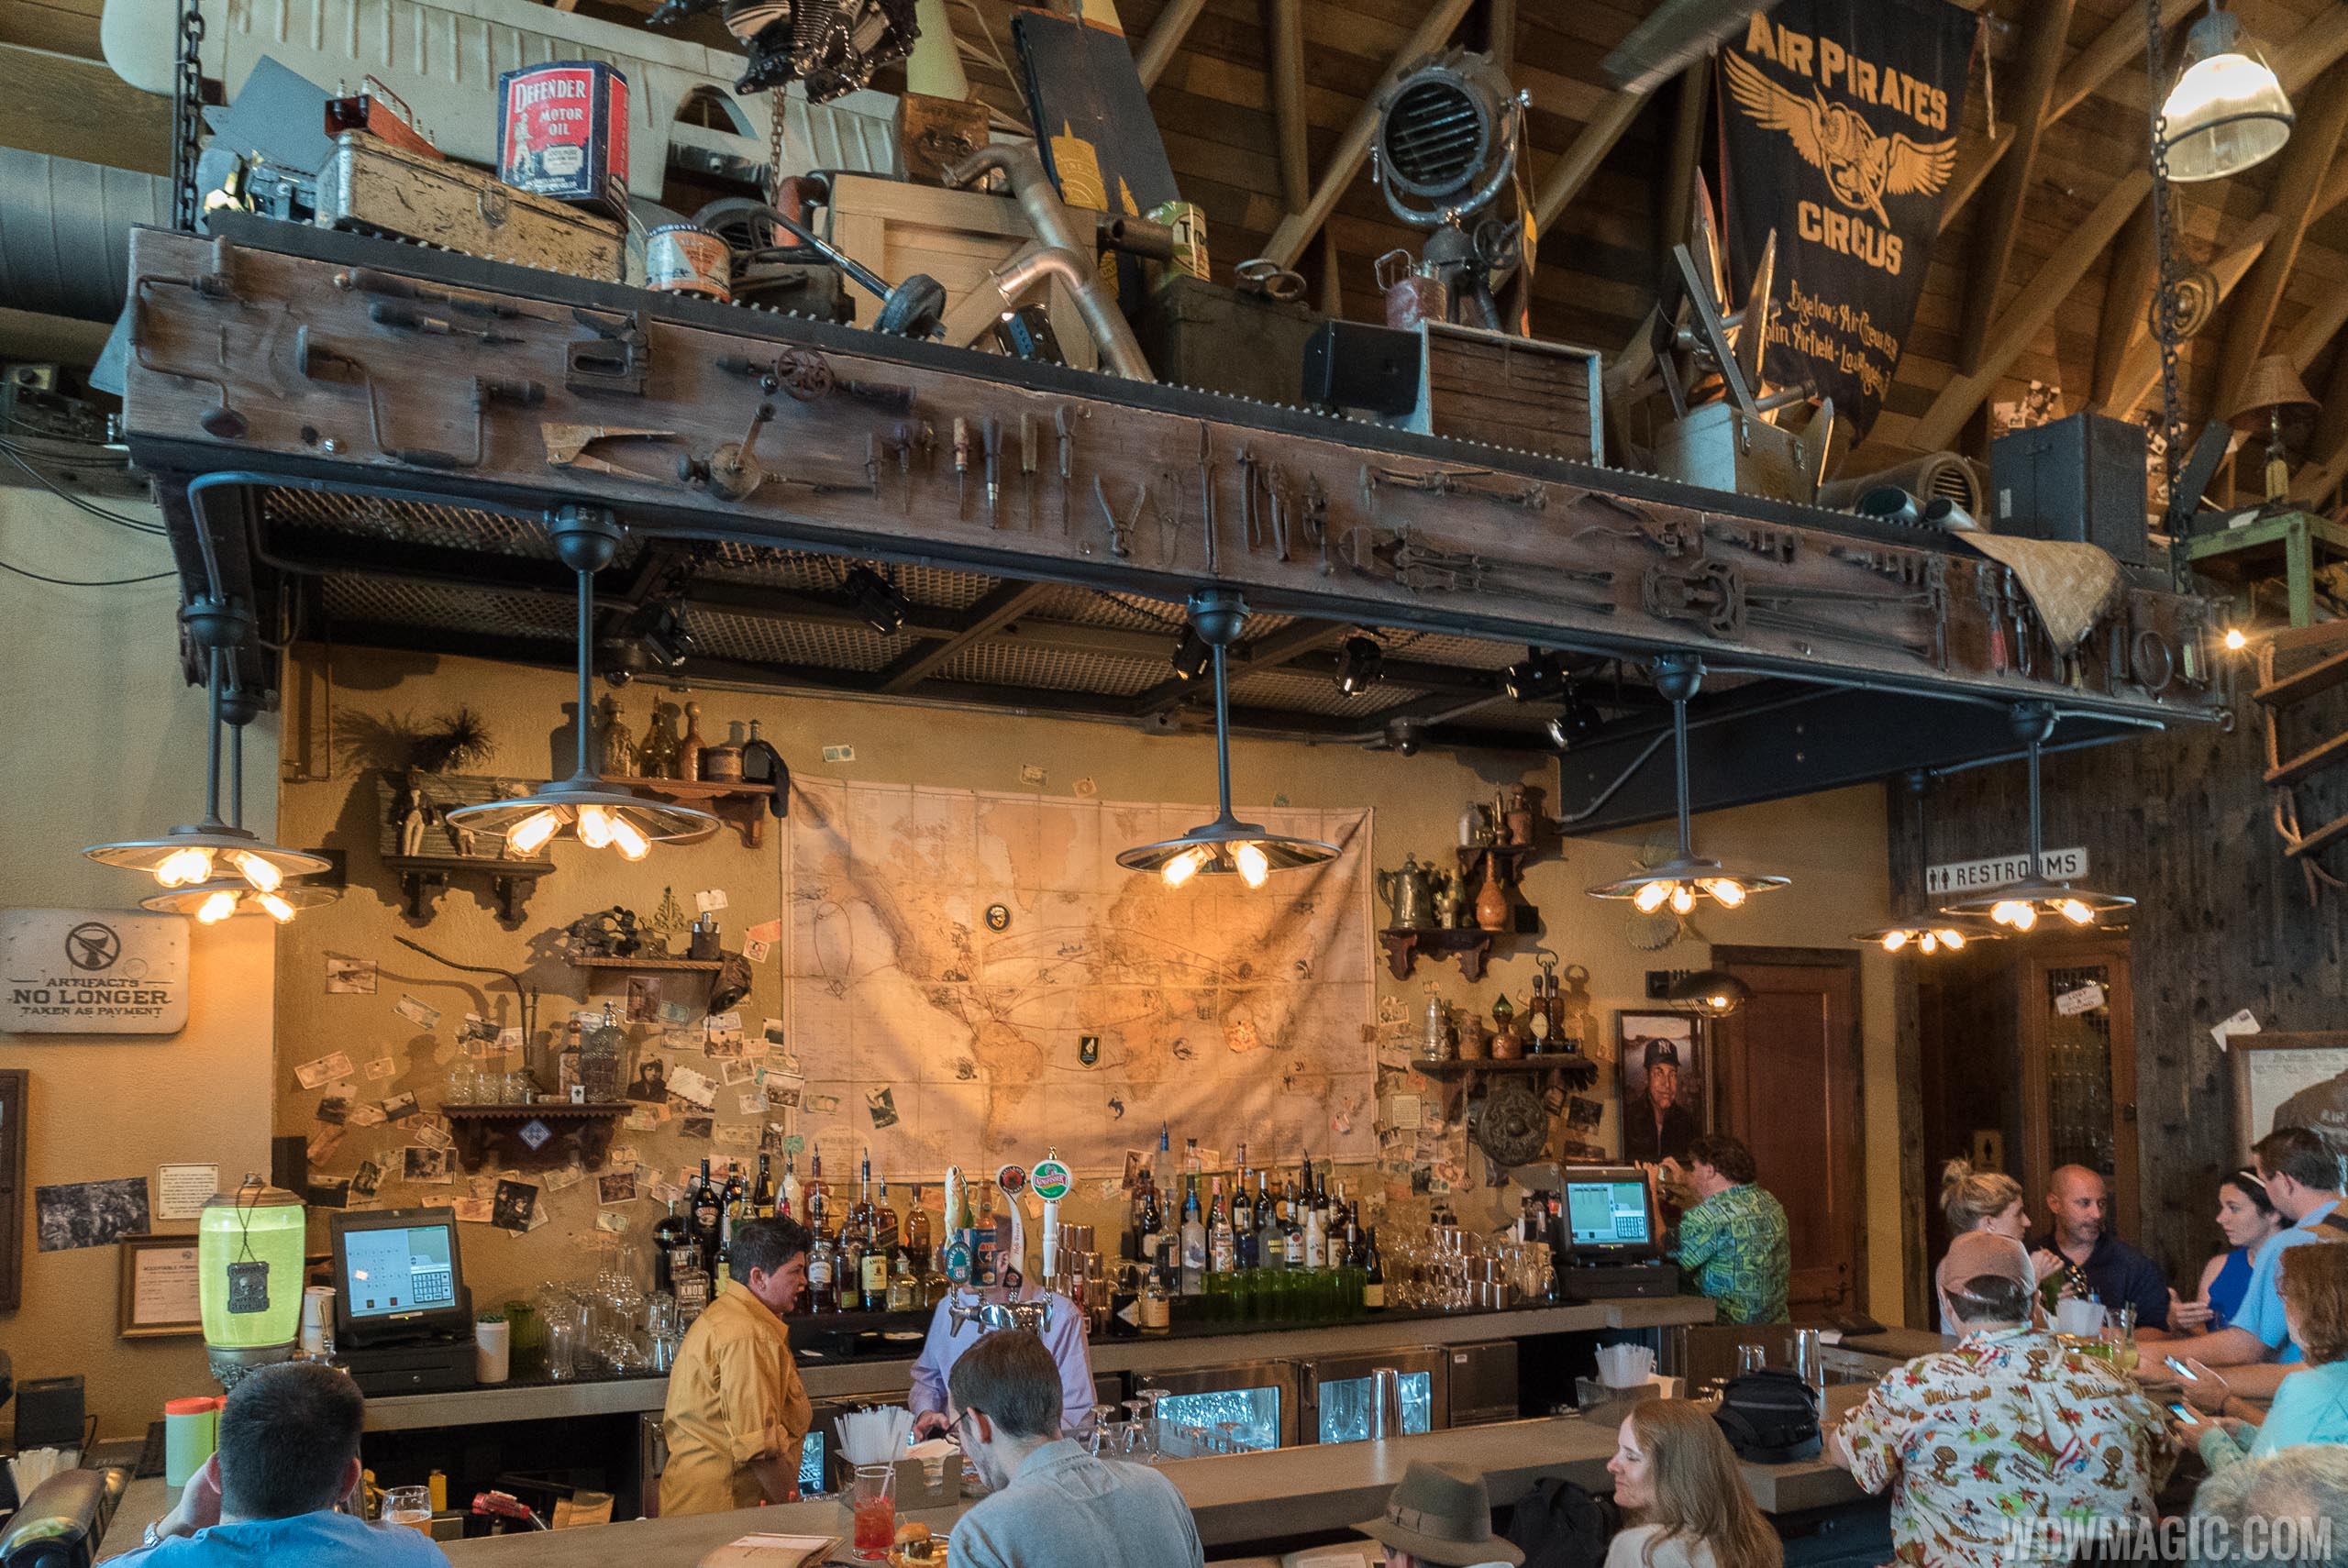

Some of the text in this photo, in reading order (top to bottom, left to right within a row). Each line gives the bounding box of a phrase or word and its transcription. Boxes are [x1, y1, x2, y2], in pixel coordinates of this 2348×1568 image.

[1745, 10, 1948, 132] AIR PIRATES
[514, 79, 587, 114] DEFENDER
[539, 107, 584, 123] MOTOR
[548, 123, 571, 136] OIL
[1798, 200, 1903, 276] CIRCUS
[1792, 321, 1834, 362] Airfield
[1956, 854, 2077, 887] RESTROMS
[46, 977, 140, 988] ARTIFACTS
[13, 989, 172, 1005] NO LONGER
[21, 1007, 163, 1015] TAKEN AS PAYMENT
[681, 1285, 703, 1296] KNOB
